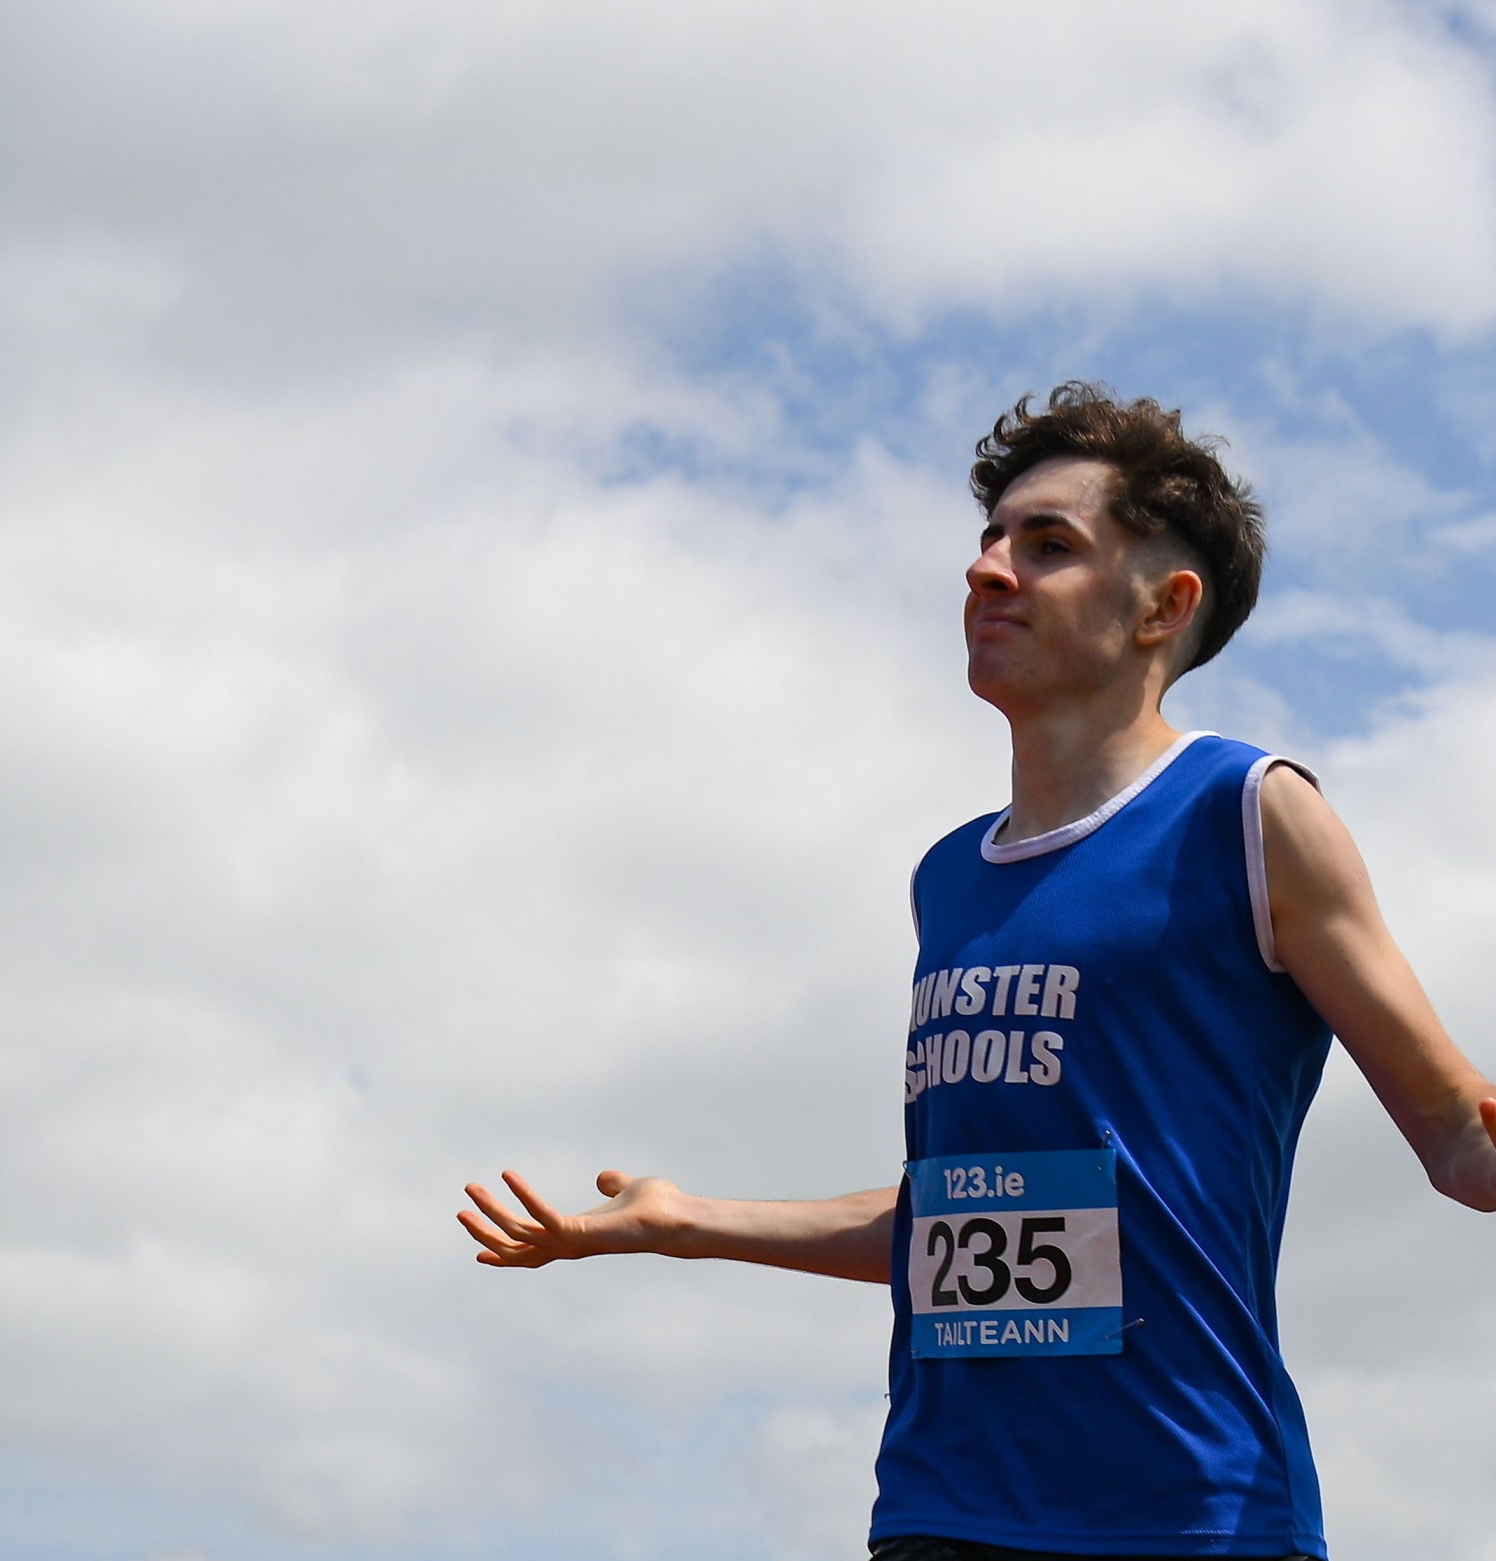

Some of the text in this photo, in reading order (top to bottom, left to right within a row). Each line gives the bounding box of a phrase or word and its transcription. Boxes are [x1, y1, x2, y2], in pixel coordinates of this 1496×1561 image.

[944, 1165, 1026, 1199] 123.ie
[927, 1216, 1072, 1306] 235
[934, 1318, 1071, 1347] TAILTEANN
